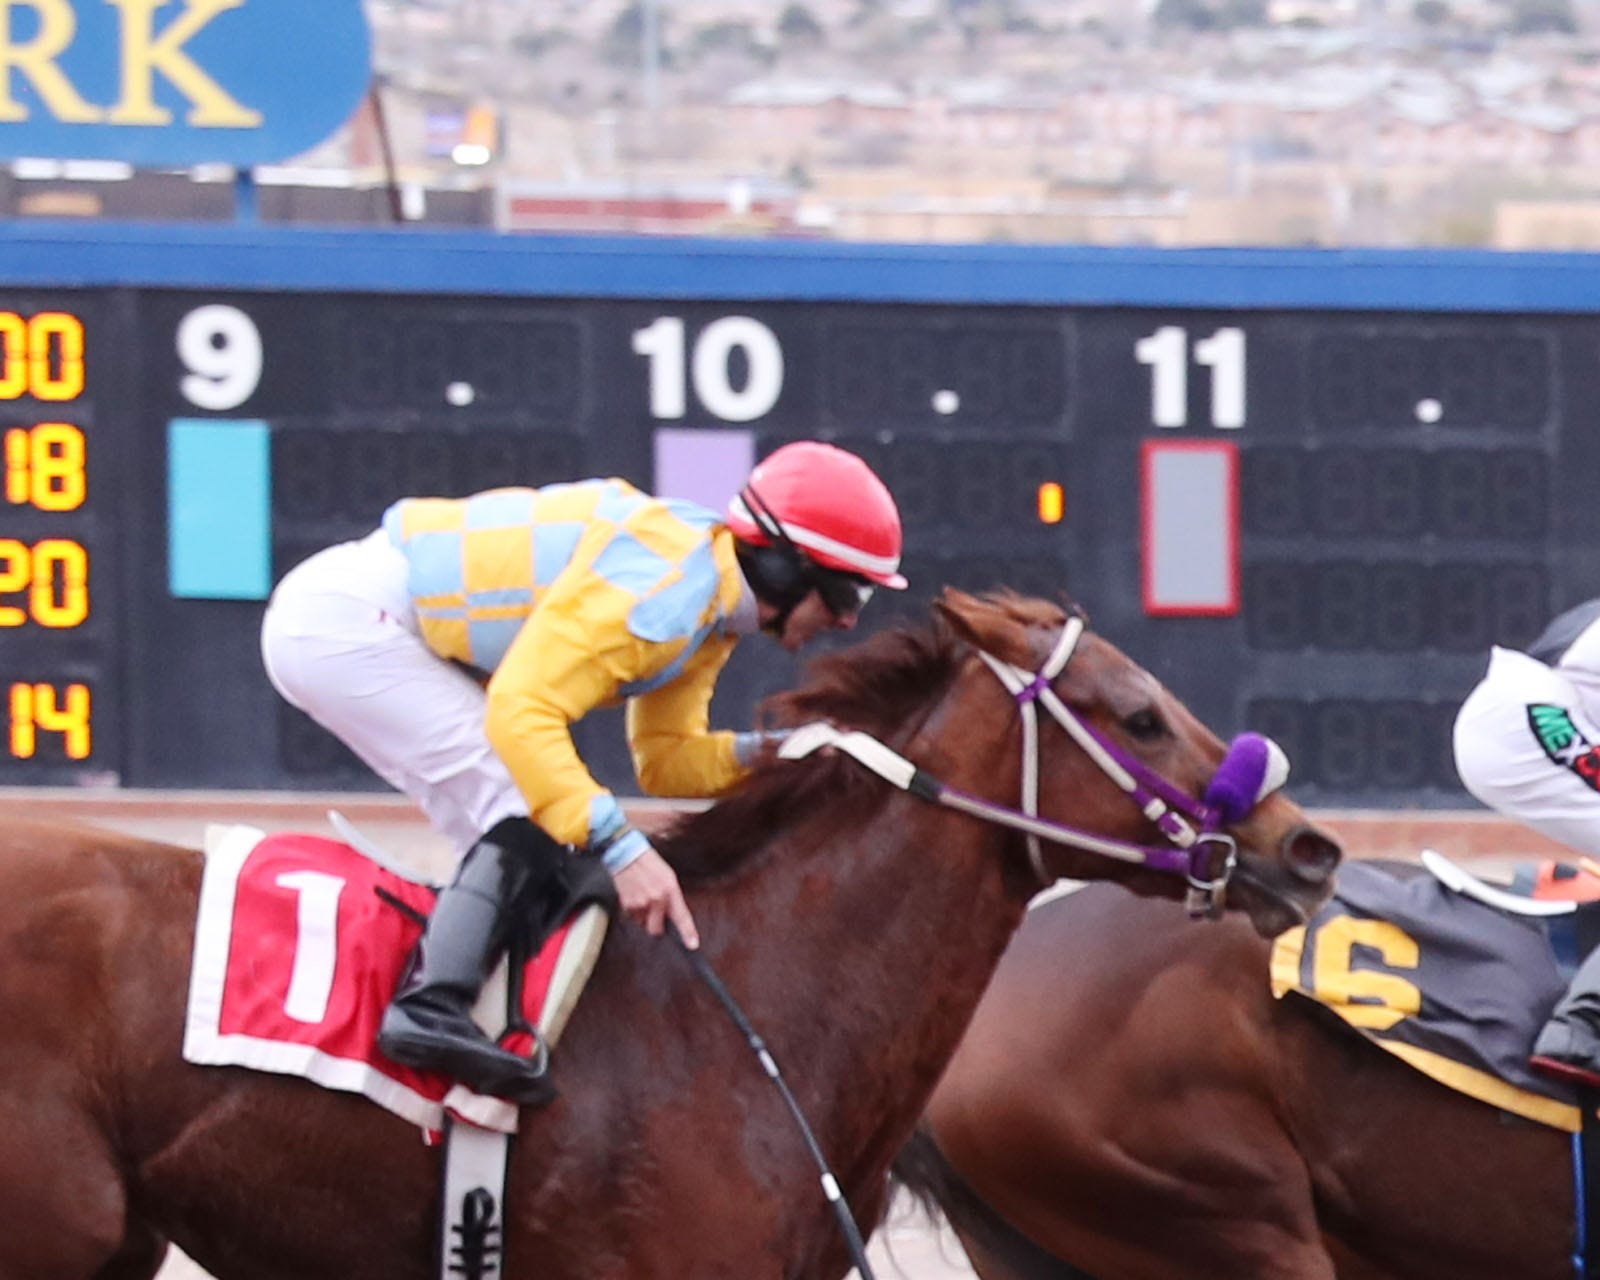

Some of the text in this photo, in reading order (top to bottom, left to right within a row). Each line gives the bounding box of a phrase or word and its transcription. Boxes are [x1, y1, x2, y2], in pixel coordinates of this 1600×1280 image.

[0, 0, 264, 128] RK
[176, 304, 263, 411] 9
[632, 315, 784, 422] 10
[1135, 326, 1246, 429] 11
[5, 423, 86, 511] 18
[8, 683, 91, 760] 14
[275, 870, 346, 1024] 1
[1313, 914, 1421, 1031] 6
